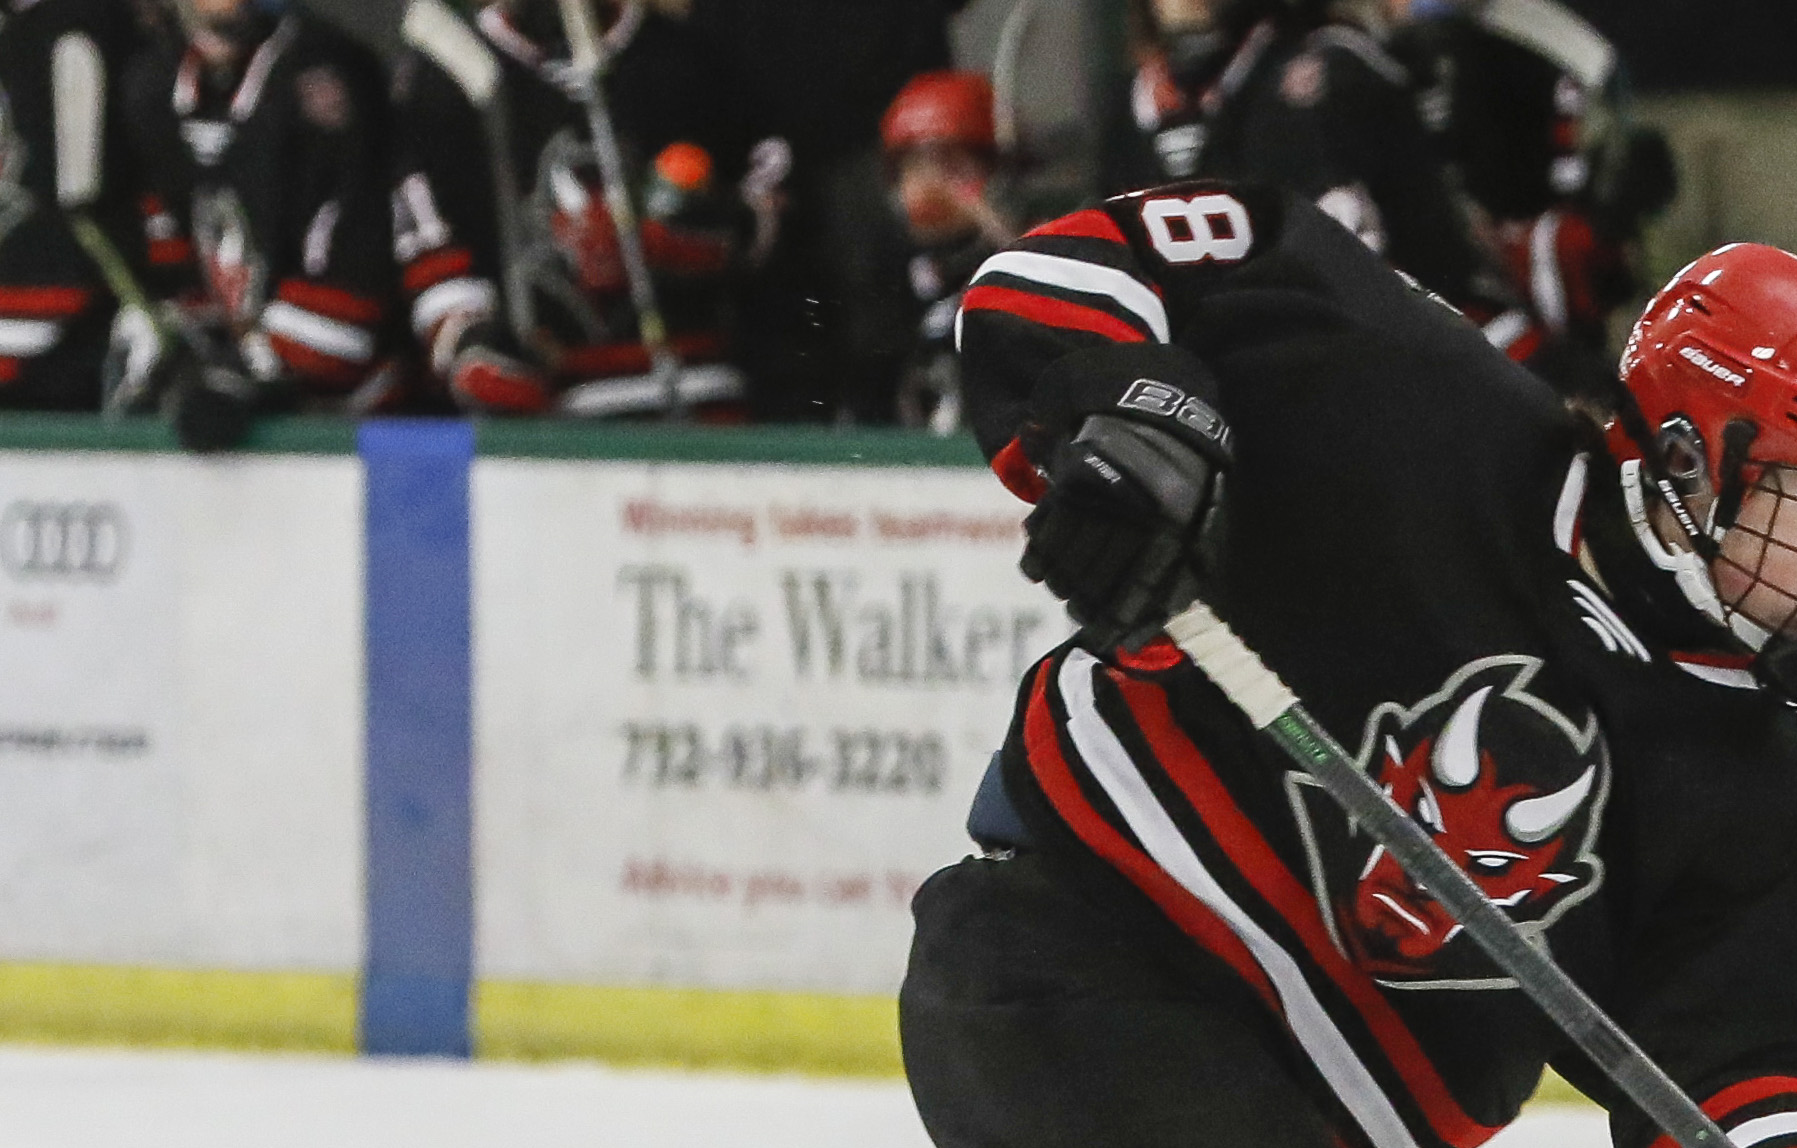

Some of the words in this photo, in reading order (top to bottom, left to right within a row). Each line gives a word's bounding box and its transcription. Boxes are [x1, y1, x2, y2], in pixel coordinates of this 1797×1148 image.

[1105, 187, 1254, 264] 8
[616, 563, 760, 684] The
[780, 567, 1046, 684] Walker
